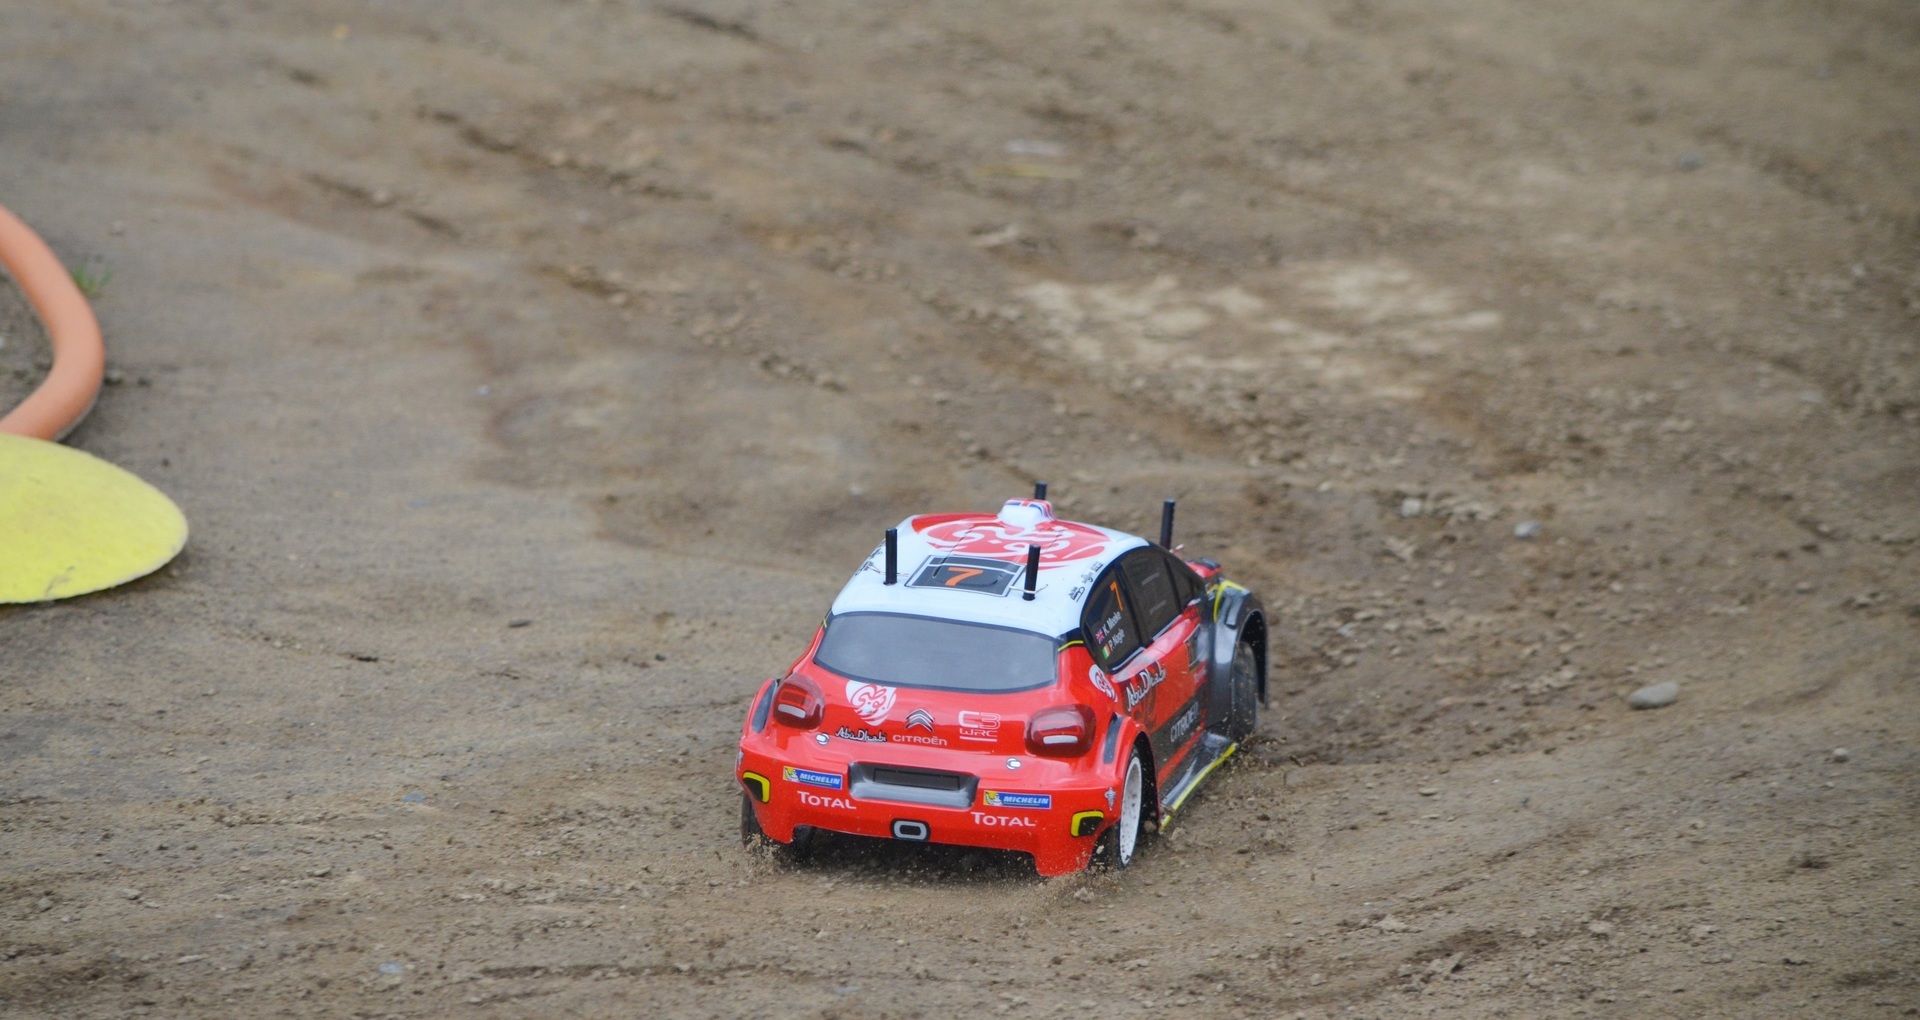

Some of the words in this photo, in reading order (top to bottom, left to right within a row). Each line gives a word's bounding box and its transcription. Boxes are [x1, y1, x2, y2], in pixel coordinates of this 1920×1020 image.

[944, 567, 984, 587] 7
[957, 710, 1001, 730] C3
[959, 728, 998, 738] WRC
[799, 773, 841, 785] MICHELIN
[797, 791, 857, 809] TOTAL
[1003, 796, 1049, 805] MICHELIN
[970, 811, 1036, 827] TOTAL
